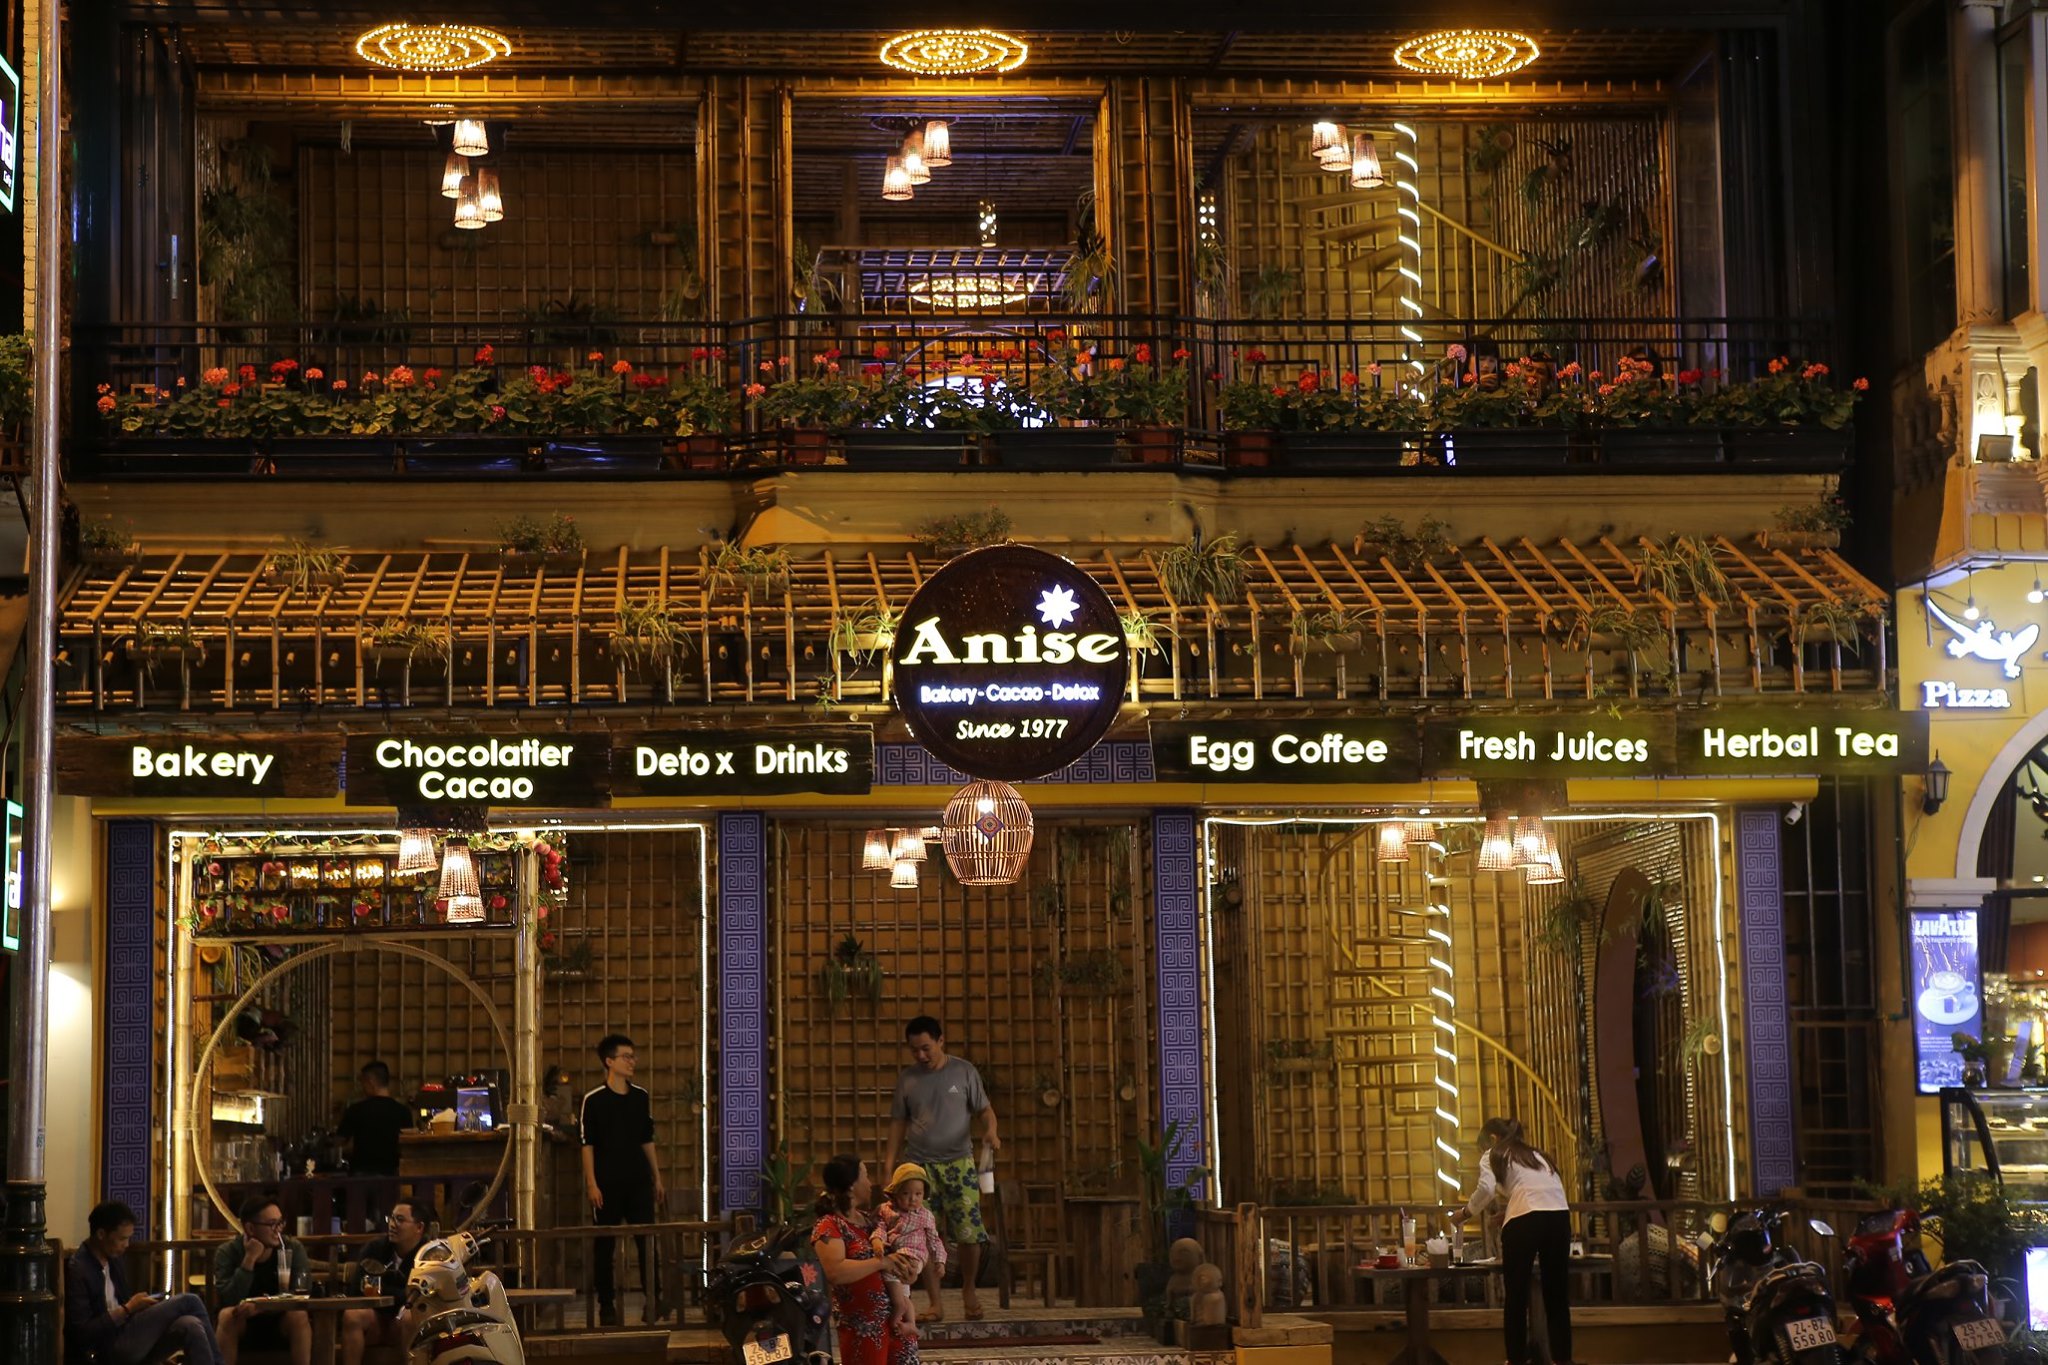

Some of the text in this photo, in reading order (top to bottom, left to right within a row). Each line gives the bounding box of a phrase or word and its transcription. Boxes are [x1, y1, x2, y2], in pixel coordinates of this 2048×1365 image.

[899, 616, 1119, 665] Anise
[1923, 681, 2011, 708] Pizza
[956, 718, 1069, 740] Since 1977
[1704, 727, 1898, 758] Herbal Tea
[376, 739, 574, 768] Chocolatier
[636, 743, 848, 776] Detox Drinks
[1190, 733, 1388, 772] Egg Coffee
[1460, 730, 1648, 762] Fresh Juices
[132, 745, 274, 785] Bakery
[419, 771, 534, 799] Cacao
[1914, 913, 1977, 936] LAVAZZ
[1793, 1330, 1834, 1349] 558.80
